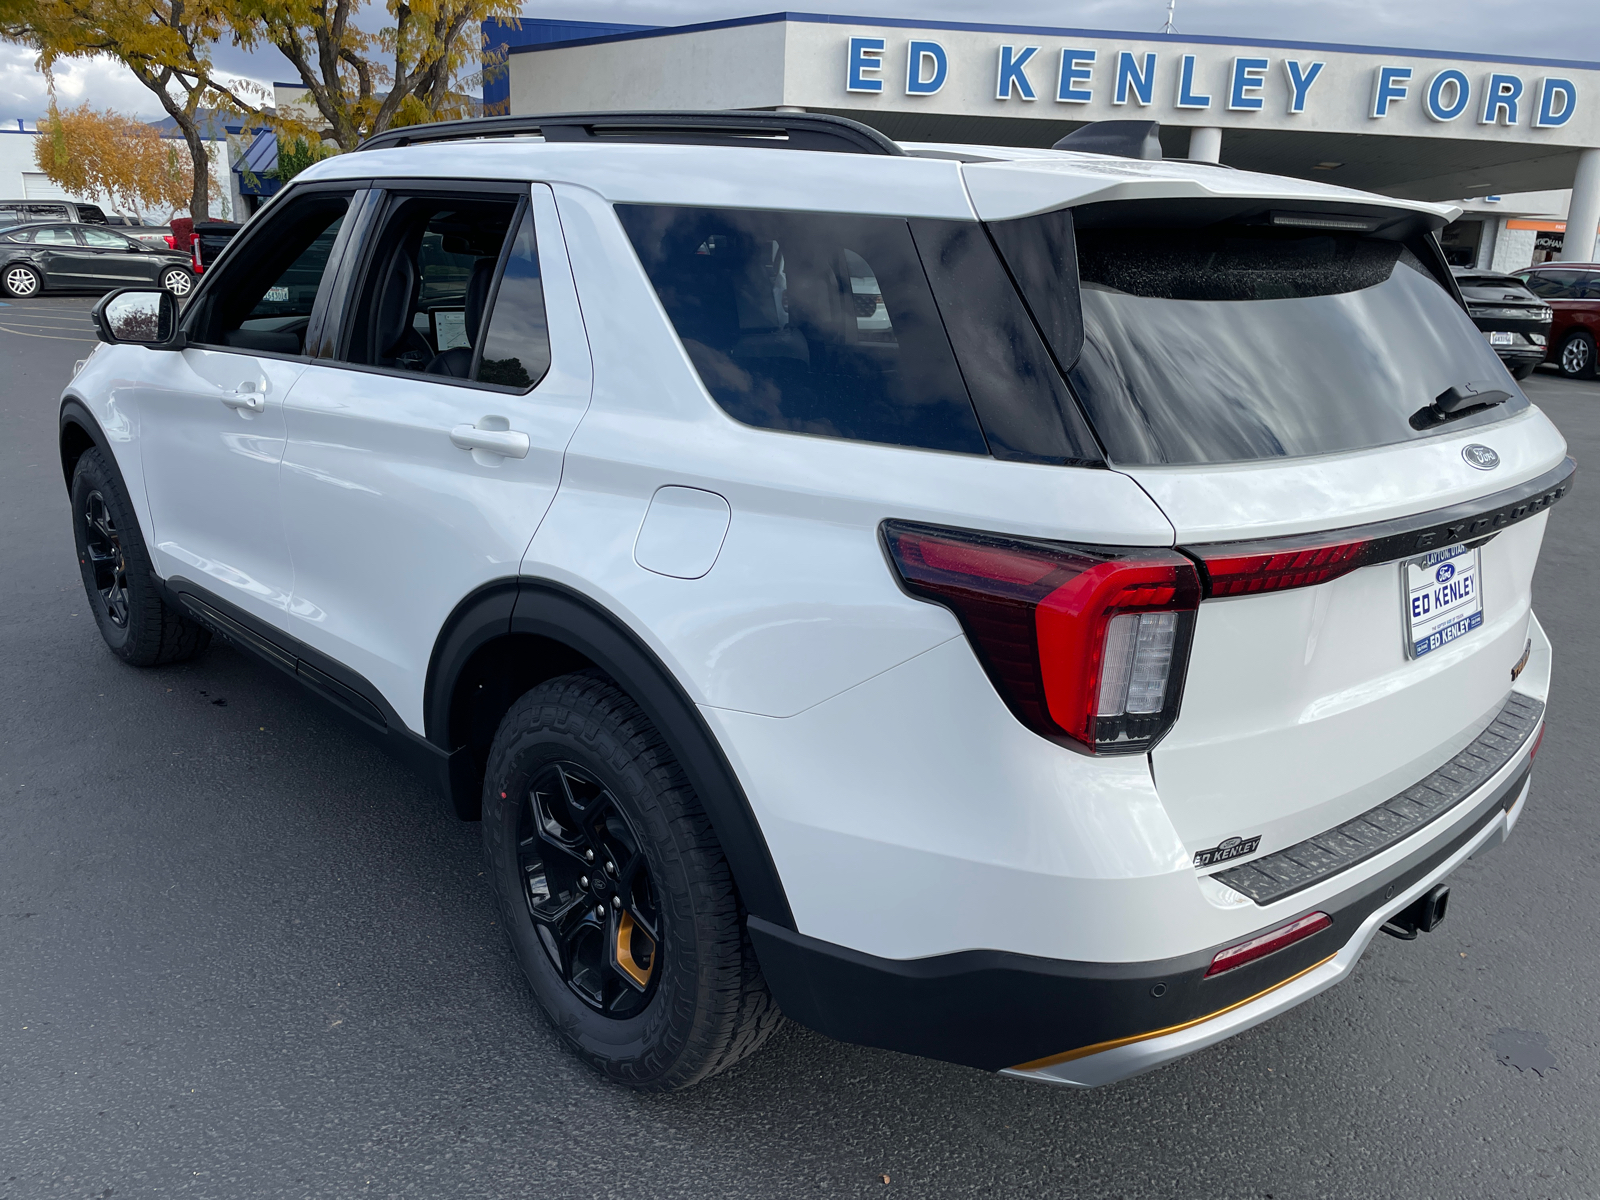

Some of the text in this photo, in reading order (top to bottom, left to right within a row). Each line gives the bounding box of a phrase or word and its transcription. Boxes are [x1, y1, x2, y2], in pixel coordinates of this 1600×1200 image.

[846, 36, 1578, 129] ED KENLEY FORD
[1438, 565, 1453, 582] Ford
[1412, 574, 1475, 618] ED KENLEY
[1429, 633, 1441, 650] ED
[1442, 617, 1470, 644] KENLEY
[1213, 840, 1260, 862] KENLEY
